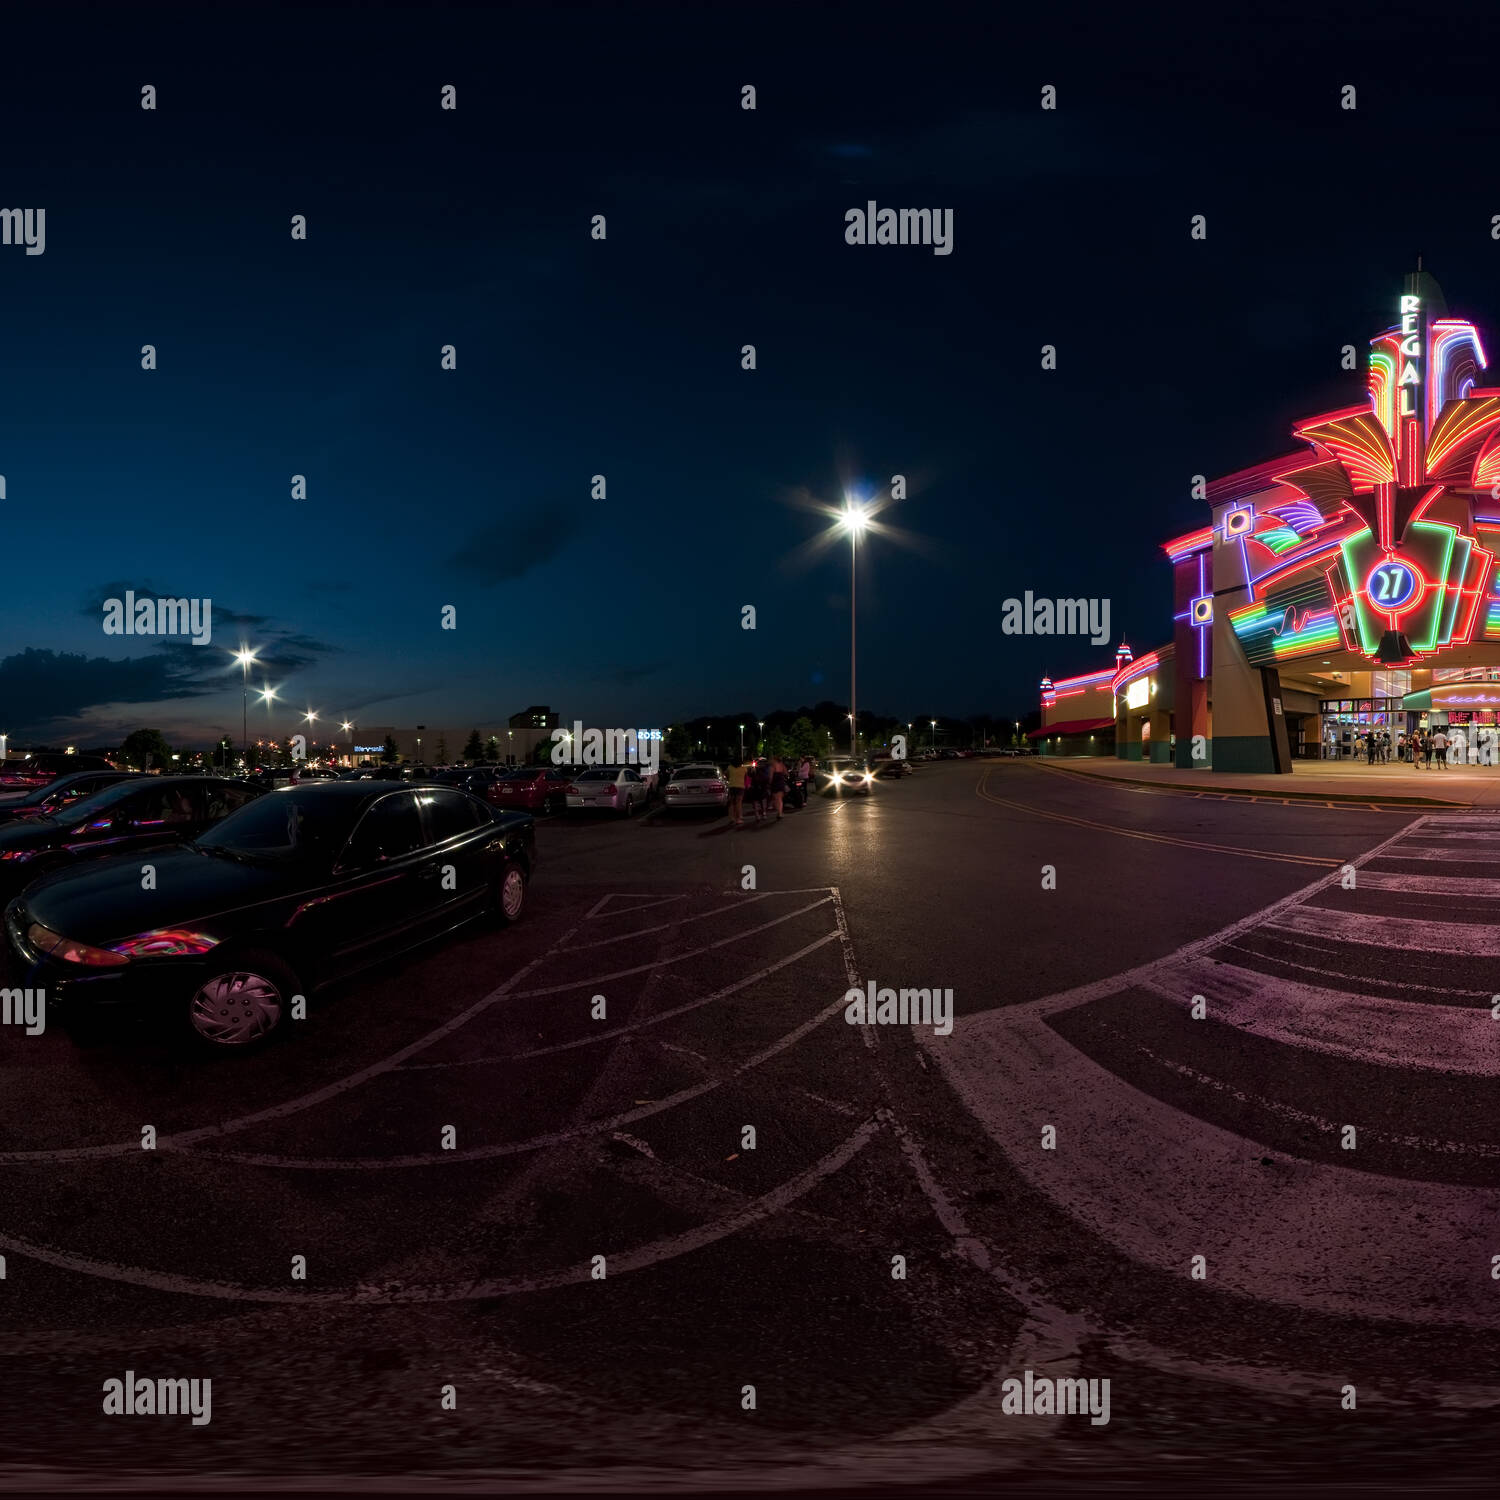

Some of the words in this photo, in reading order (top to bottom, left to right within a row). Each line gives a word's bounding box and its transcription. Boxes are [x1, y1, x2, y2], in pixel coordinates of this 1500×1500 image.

[1398, 295, 1420, 416] REGAL
[1377, 568, 1404, 600] 27
[638, 731, 662, 740] ROSS
